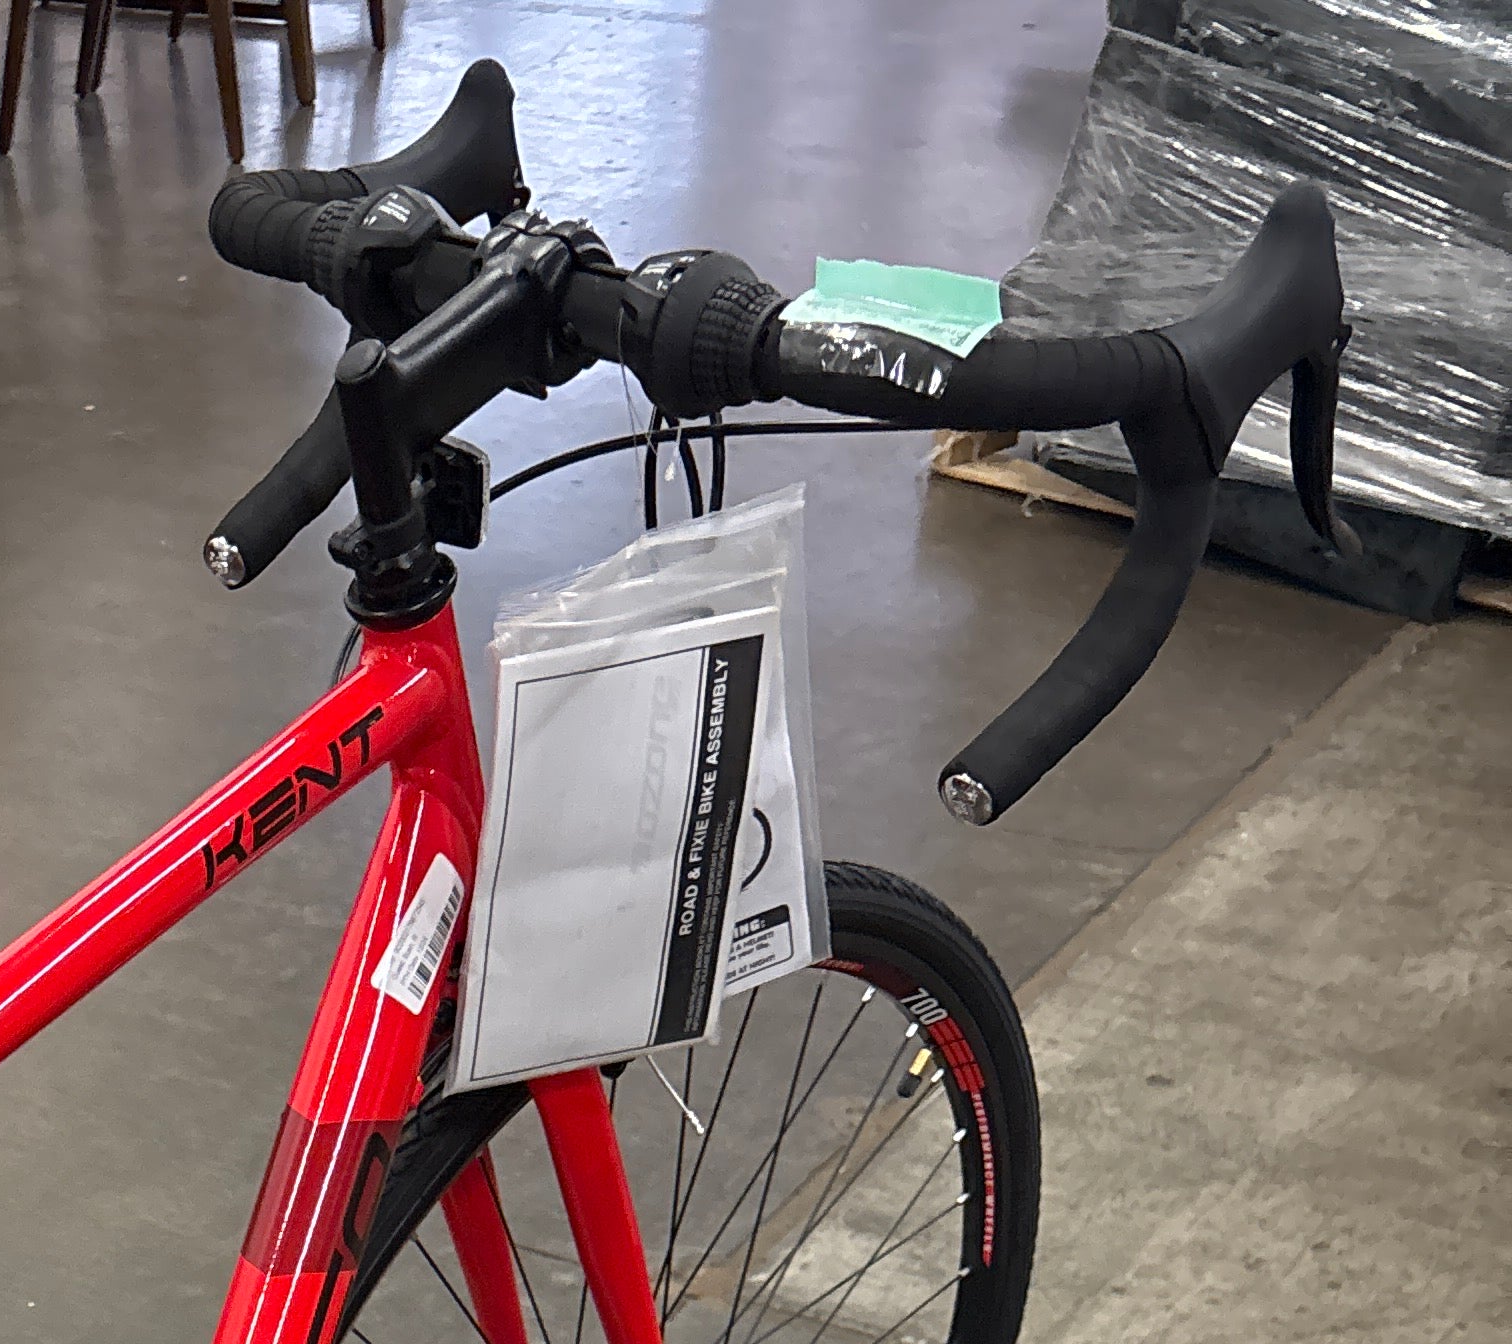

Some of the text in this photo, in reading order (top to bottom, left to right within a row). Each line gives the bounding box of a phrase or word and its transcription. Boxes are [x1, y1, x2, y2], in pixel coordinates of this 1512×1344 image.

[706, 659, 728, 765] ASSEMBLY
[201, 706, 384, 890] KENT
[698, 769, 717, 815] BIKE
[689, 818, 709, 863] FIXIE
[688, 867, 701, 880] &
[679, 884, 698, 936] ROAD
[900, 987, 948, 1026] 700
